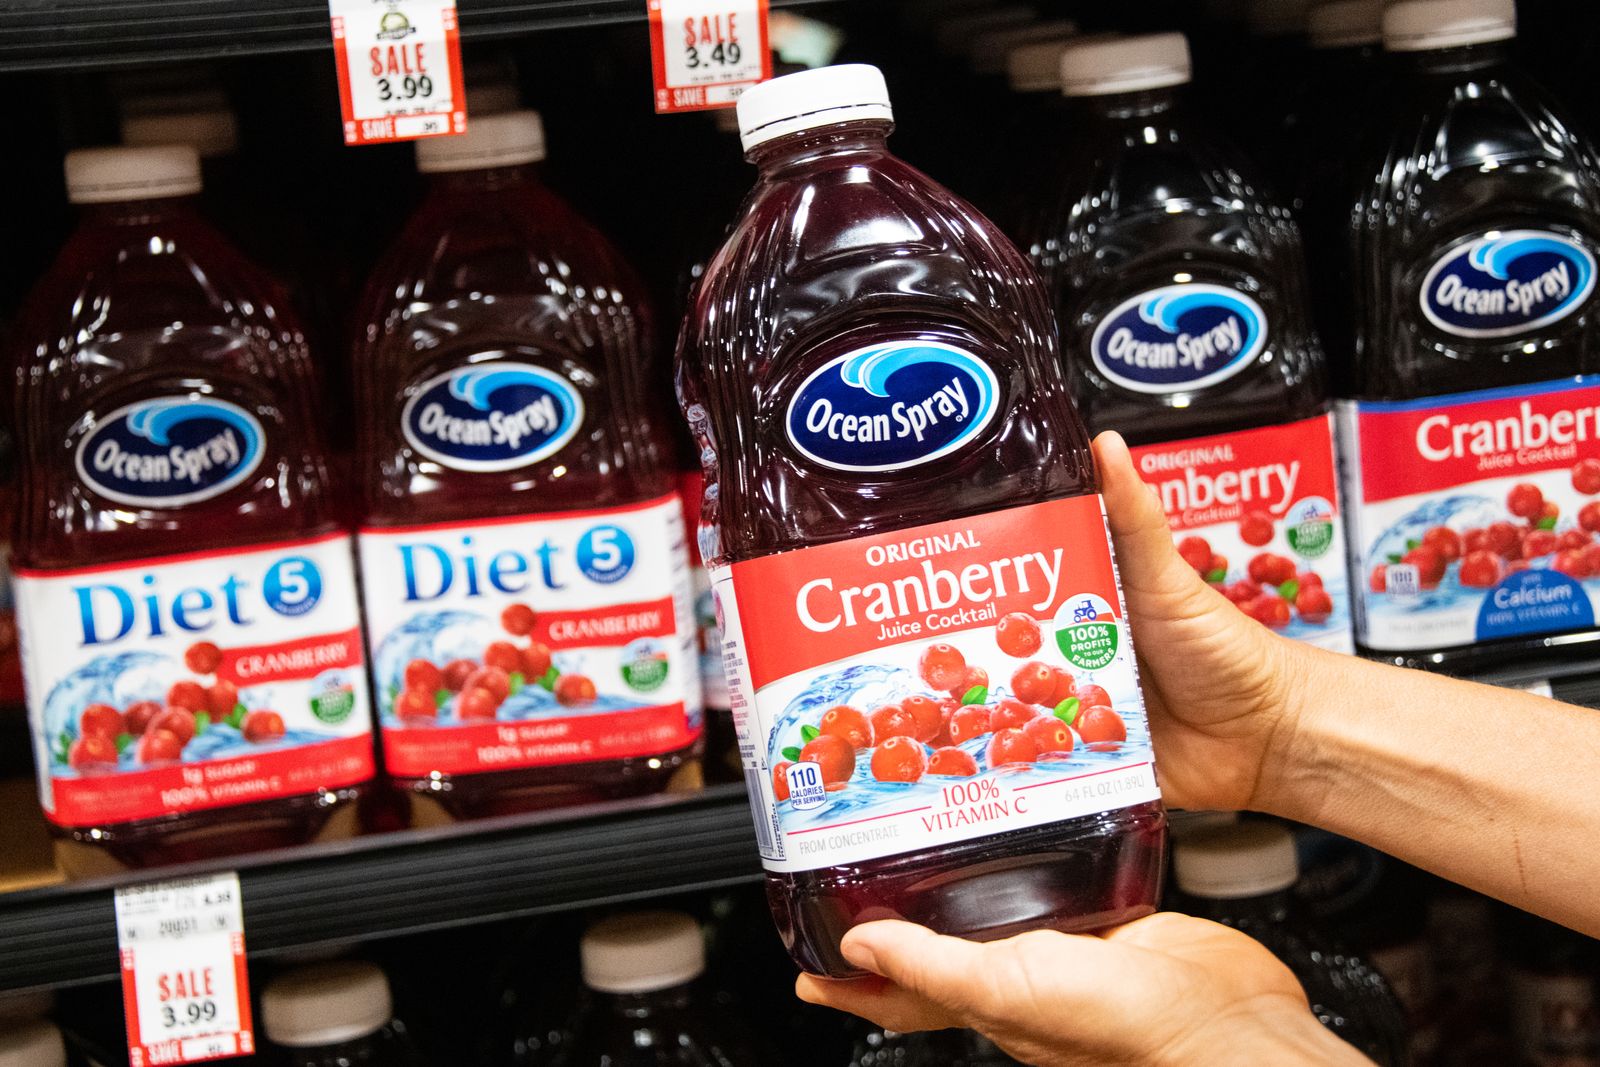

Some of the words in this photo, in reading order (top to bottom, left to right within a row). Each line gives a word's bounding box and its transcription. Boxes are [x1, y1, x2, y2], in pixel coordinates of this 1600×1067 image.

[683, 13, 739, 46] SALE
[369, 43, 427, 76] SALE
[685, 42, 741, 69] 3.49
[376, 75, 433, 101] 3.99
[673, 87, 707, 108] SAVE
[361, 117, 395, 140] SAVE
[1436, 274, 1505, 315] Ocean
[1505, 261, 1571, 316] Spray
[1107, 327, 1178, 370] Ocean
[1176, 315, 1243, 371] Spray
[419, 401, 492, 447] Ocean
[489, 394, 559, 450] Spray
[805, 397, 891, 443] Ocean
[891, 376, 970, 443] Spray
[1415, 400, 1600, 462] Cranber
[93, 438, 169, 483] Ocean
[170, 427, 241, 485] Spray
[1140, 444, 1234, 474] ORIGINAL
[1476, 450, 1515, 471] Juice
[1516, 441, 1578, 465] Cocktail
[865, 529, 981, 567] ORIGINAL
[396, 535, 569, 602] Diet
[590, 529, 623, 571] 5
[71, 573, 256, 649] Diet
[277, 562, 309, 604] 5
[795, 547, 1063, 633] Cranberry
[1493, 583, 1574, 610] Calcium
[548, 610, 663, 643] CRANBERRY
[876, 618, 922, 642] Juice
[926, 603, 998, 631] Cocktail
[1068, 624, 1109, 643] 100%
[235, 641, 348, 679] CRANBERRY
[1070, 638, 1112, 653] PROFITS
[1072, 647, 1115, 668] FARMERS
[790, 766, 817, 789] 110
[791, 785, 824, 799] CALORIES
[942, 776, 1001, 808] 100%
[792, 797, 803, 806] PER
[803, 794, 826, 805] SERVING
[1064, 788, 1080, 803] 64
[1083, 785, 1096, 799] FL
[922, 799, 1009, 833] VITAMIN
[1014, 795, 1029, 815] C
[799, 838, 827, 855] FROM
[828, 825, 899, 849] CONCENTRATE
[157, 966, 214, 1002] SALE
[162, 1000, 217, 1028] 3.99
